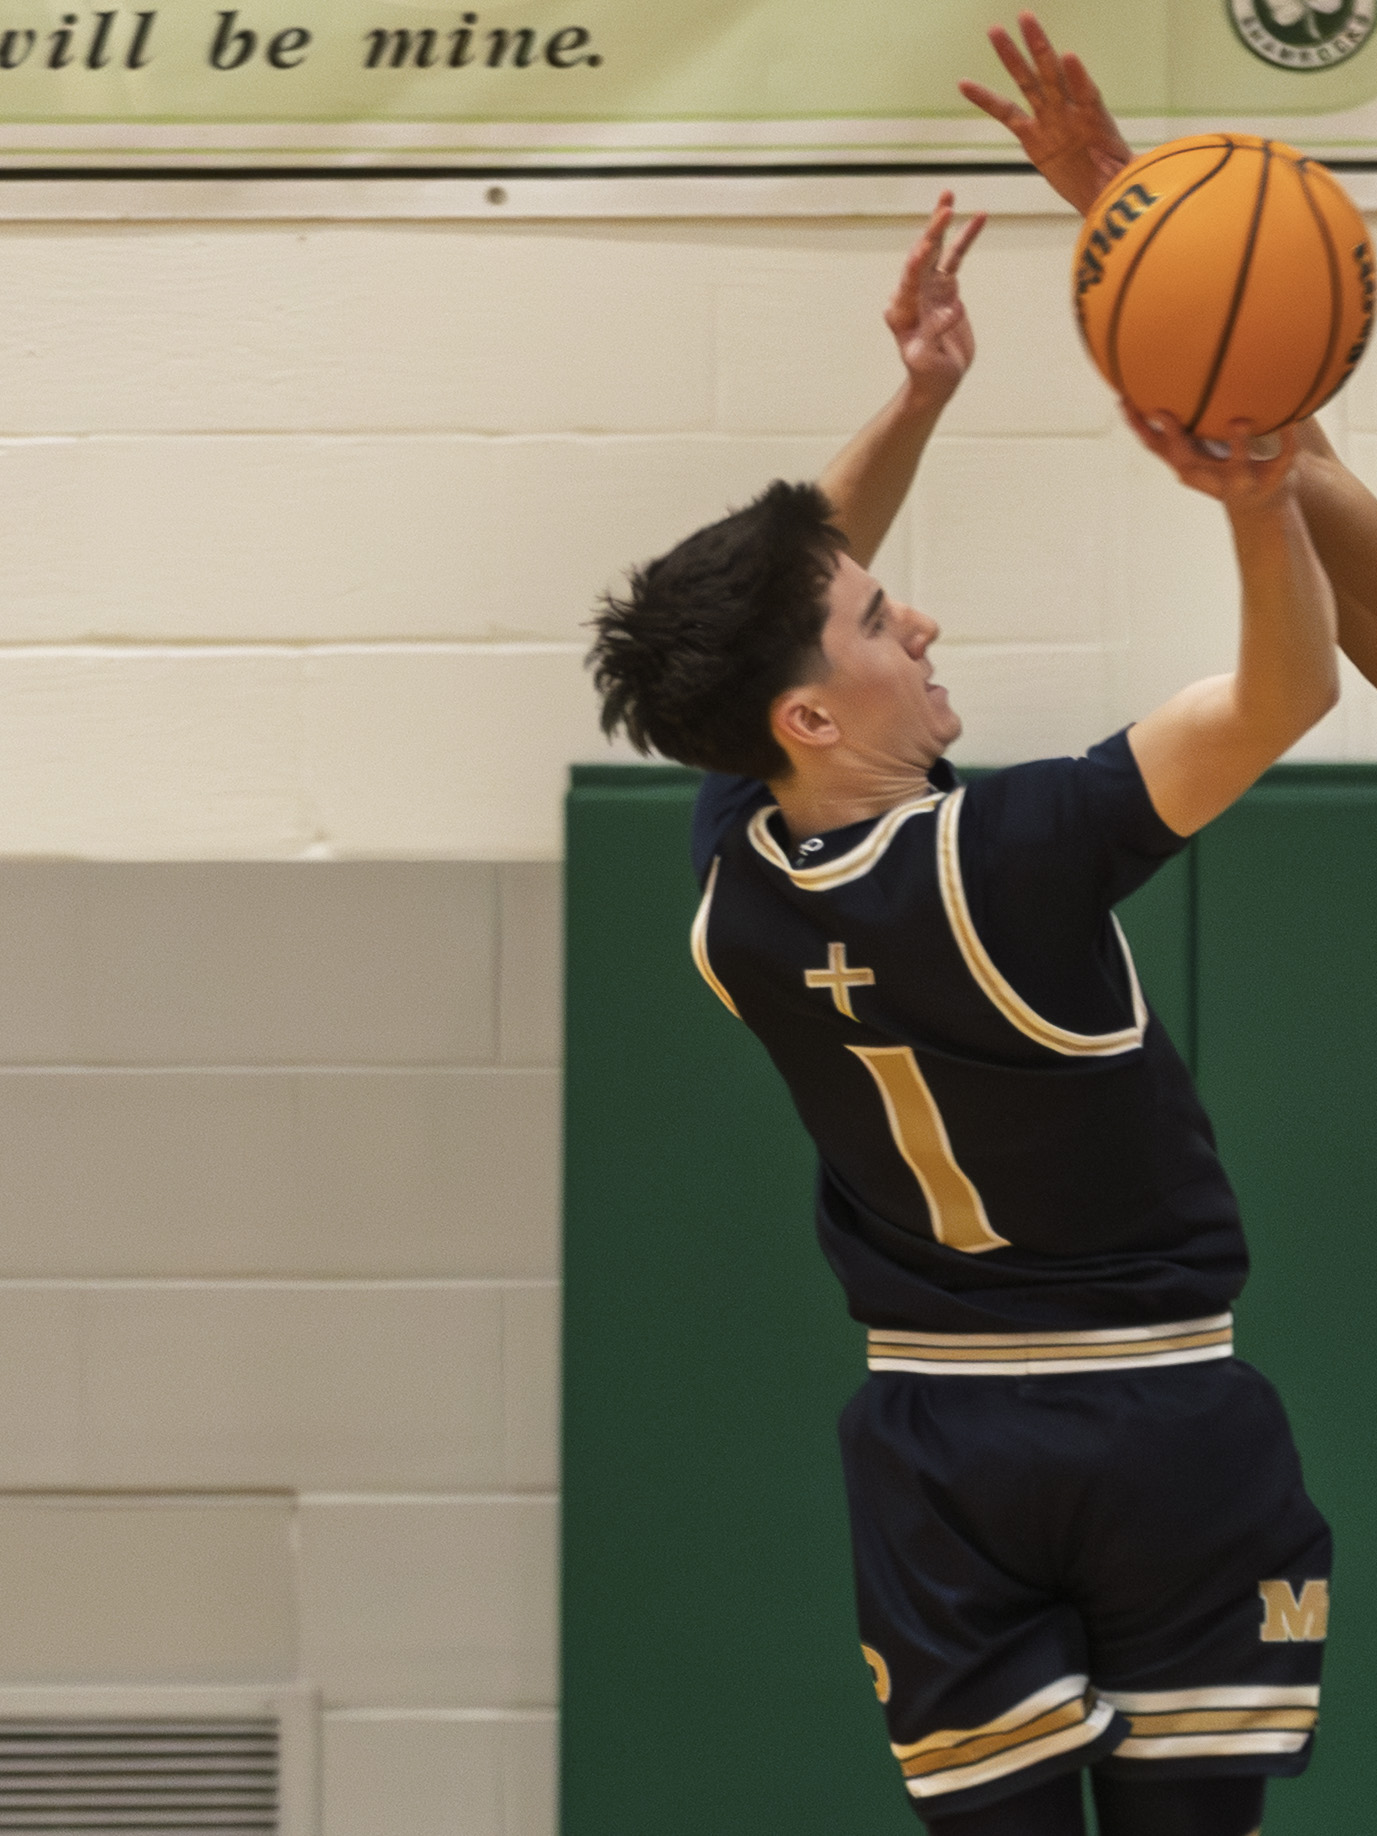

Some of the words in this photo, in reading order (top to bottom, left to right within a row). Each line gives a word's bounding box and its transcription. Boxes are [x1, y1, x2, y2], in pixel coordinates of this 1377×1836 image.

[208, 11, 312, 70] be
[364, 11, 606, 70] mine.
[844, 1045, 1012, 1254] 1
[1258, 1579, 1331, 1642] M
